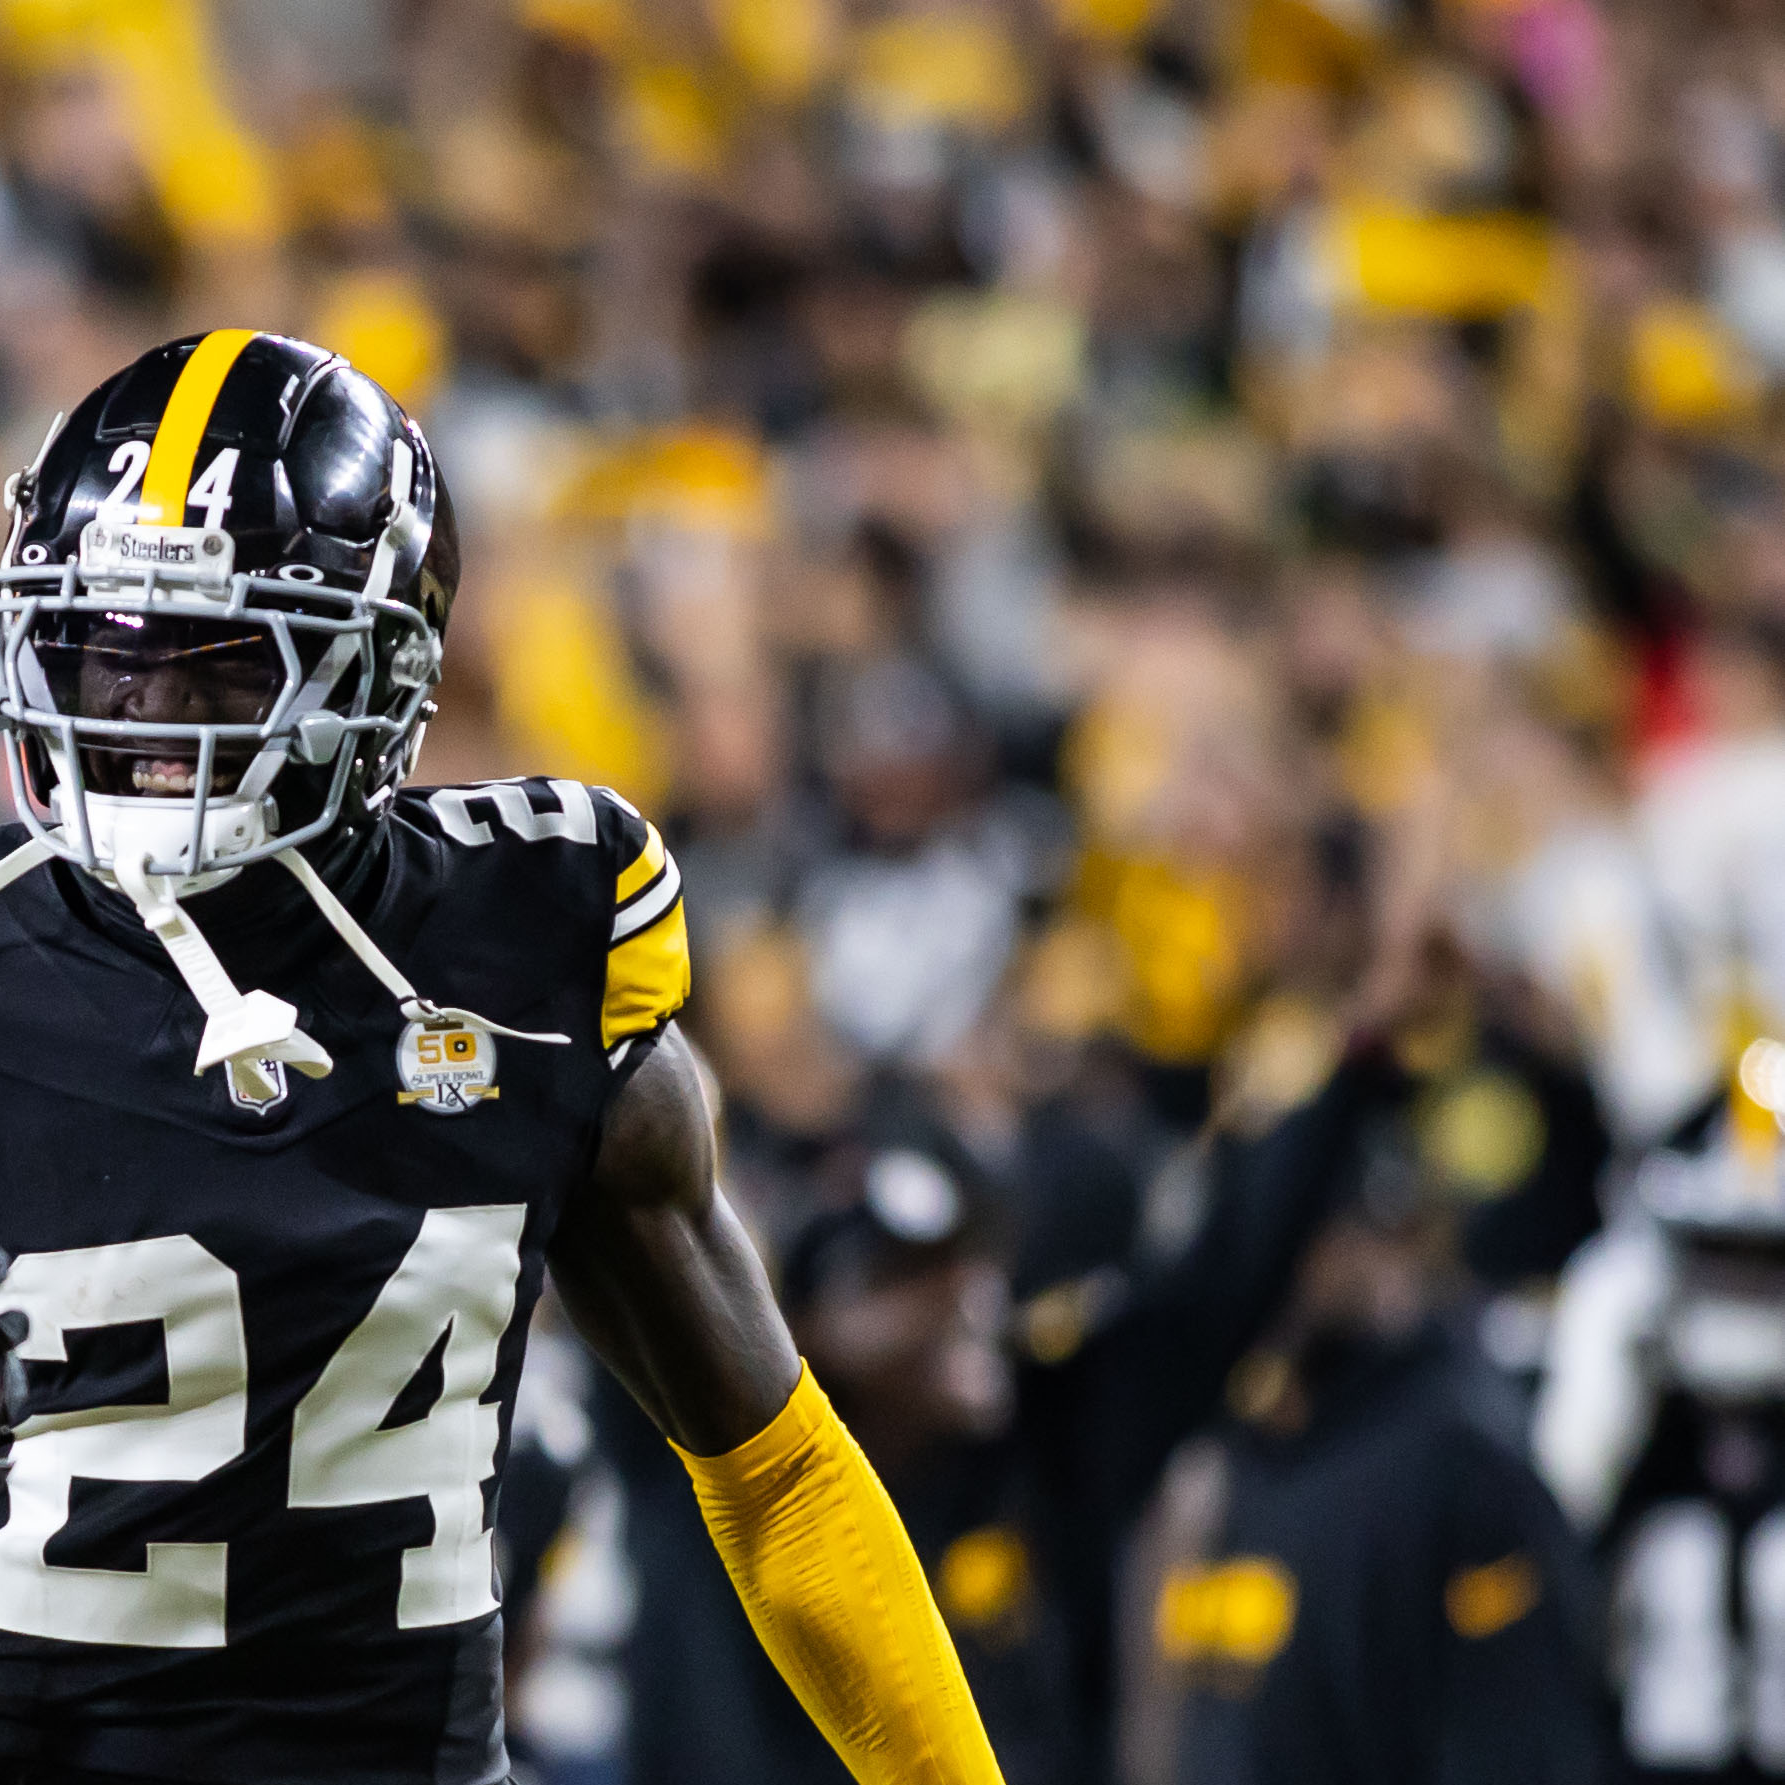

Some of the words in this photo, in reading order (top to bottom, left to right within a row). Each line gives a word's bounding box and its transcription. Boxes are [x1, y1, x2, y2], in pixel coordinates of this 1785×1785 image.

[95, 440, 241, 529] 24
[120, 533, 195, 561] Steelers
[428, 776, 598, 846] 2
[416, 1032, 478, 1064] 50
